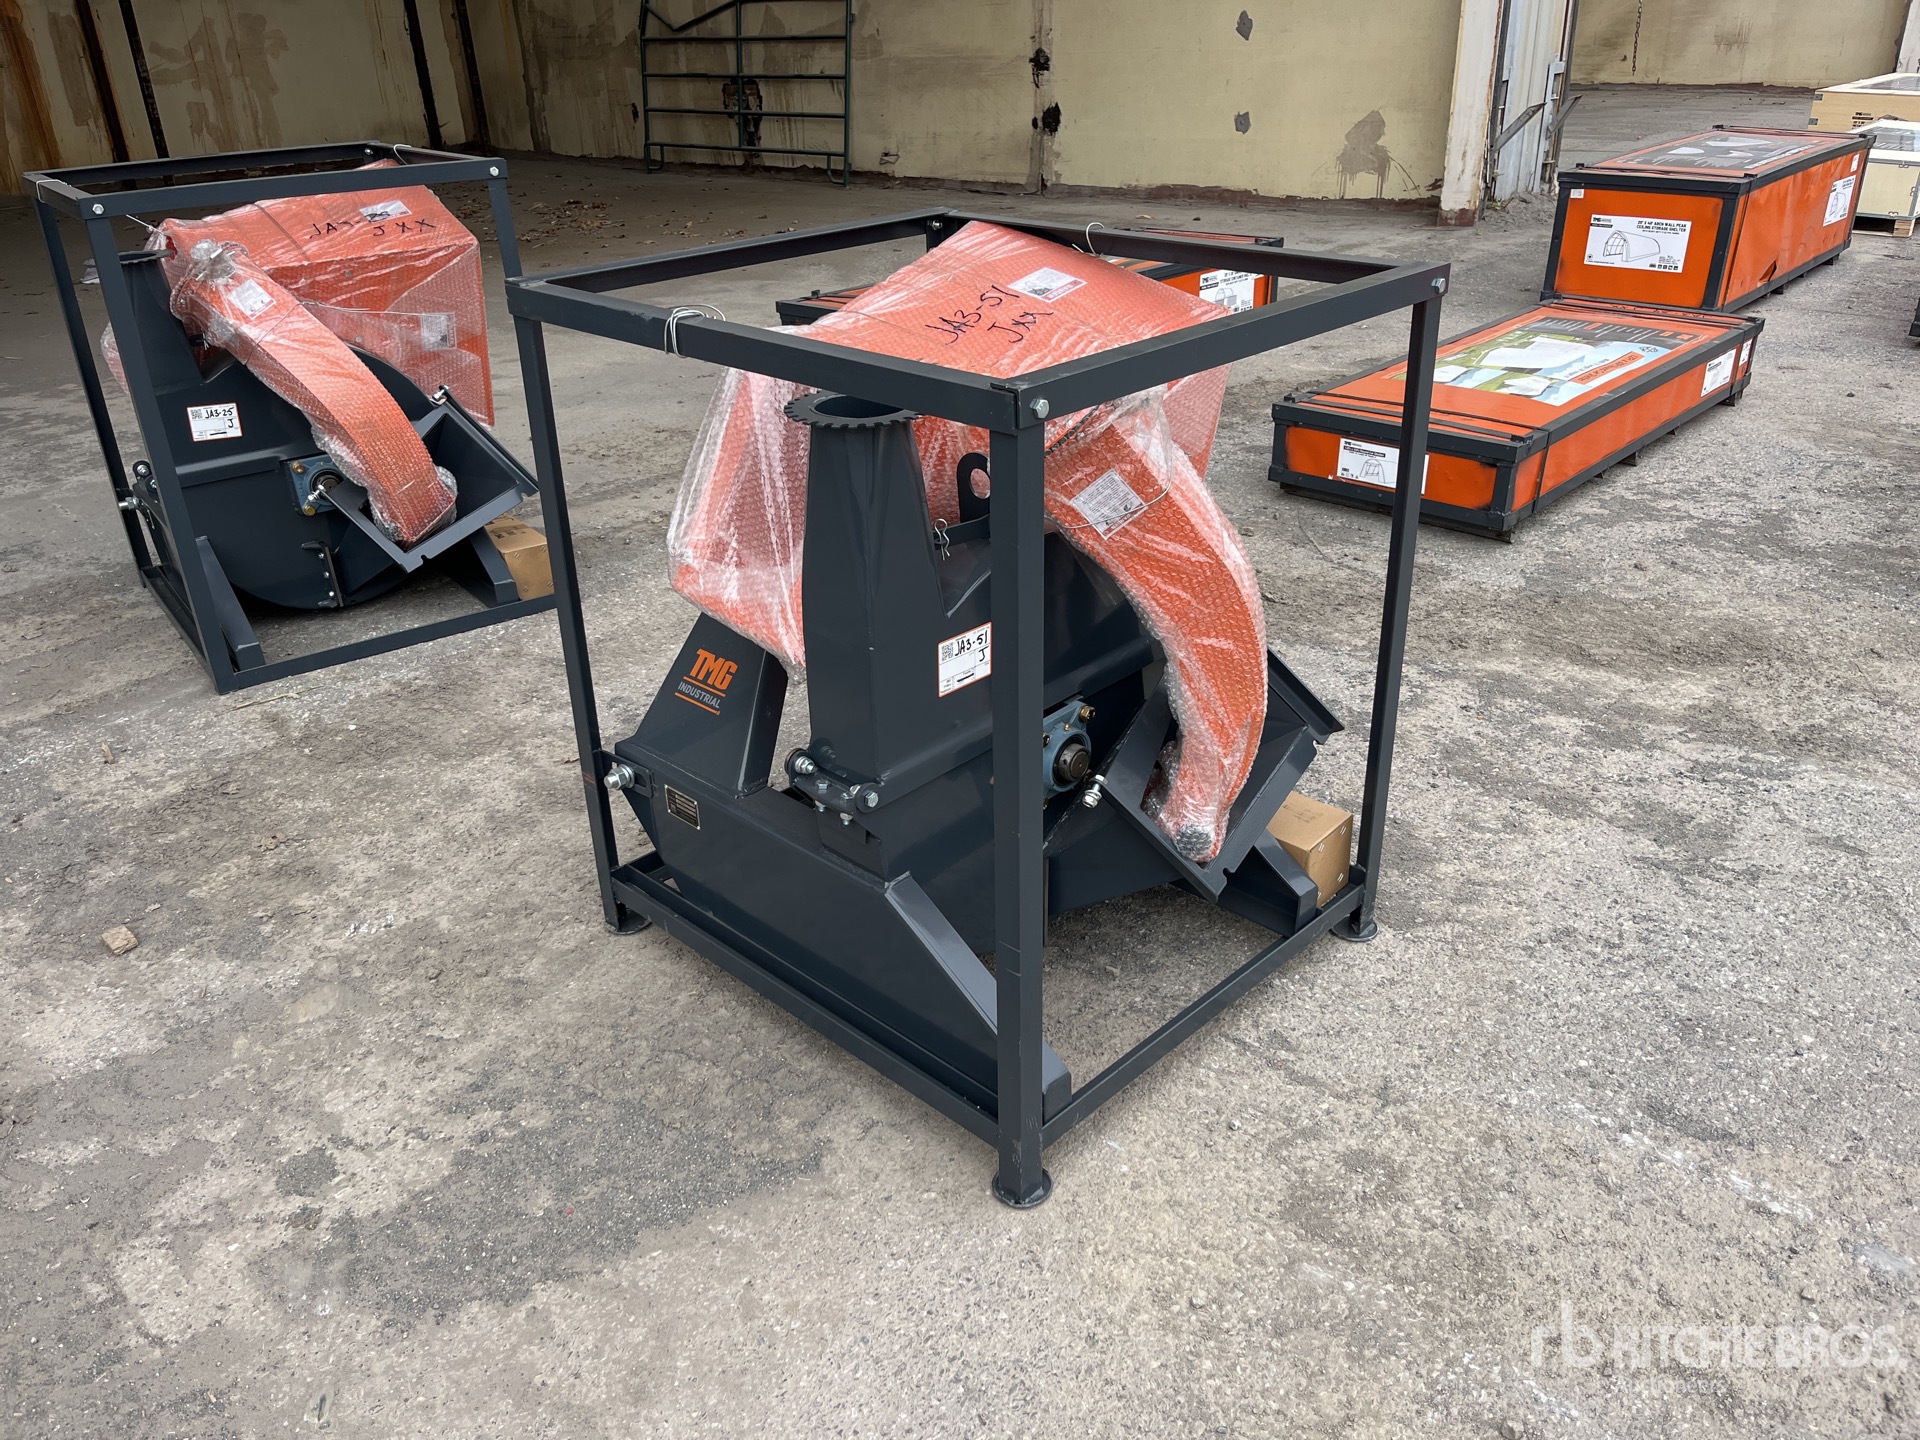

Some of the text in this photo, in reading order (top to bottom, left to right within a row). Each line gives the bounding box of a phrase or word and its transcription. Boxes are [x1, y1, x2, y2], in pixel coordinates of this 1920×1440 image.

[205, 407, 235, 419] JA3-25
[227, 418, 234, 428] J
[955, 630, 988, 657] JA3-51
[979, 645, 989, 662] J
[690, 648, 739, 690] TMG
[677, 681, 721, 709] INDUSTRIAL
